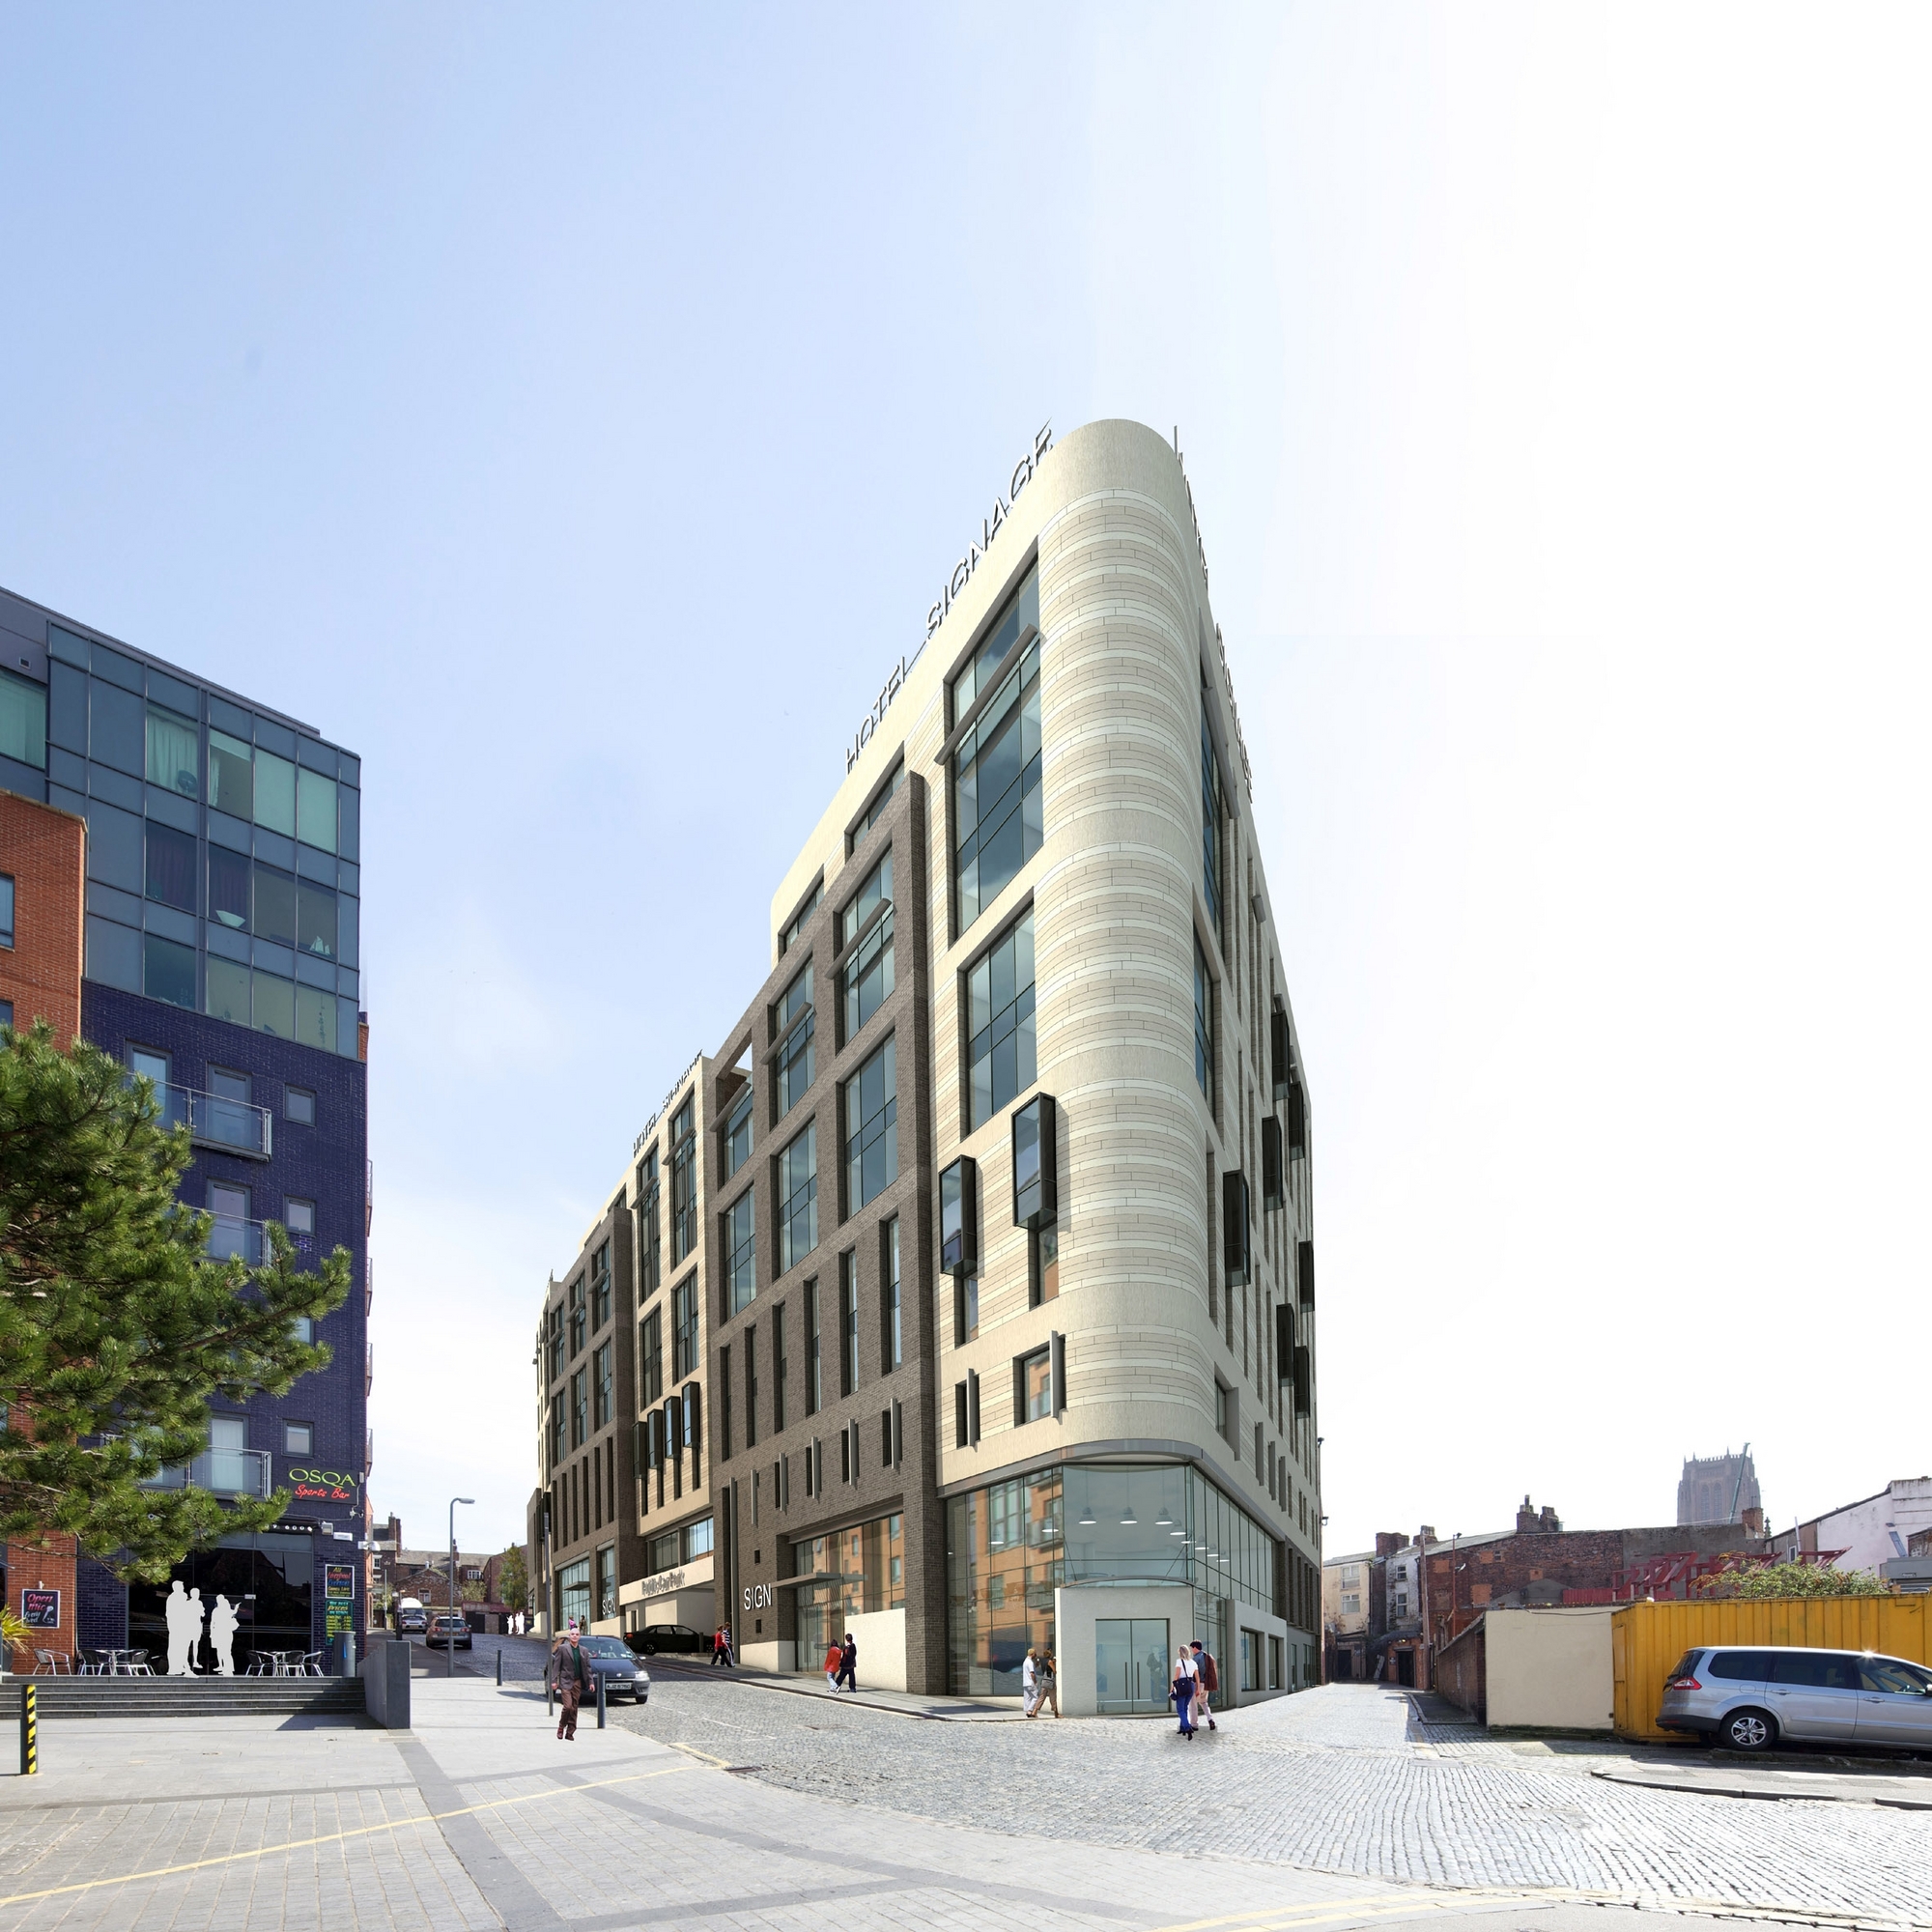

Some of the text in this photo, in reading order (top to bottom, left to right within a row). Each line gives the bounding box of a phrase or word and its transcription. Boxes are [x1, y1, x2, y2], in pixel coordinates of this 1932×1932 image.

[846, 415, 1054, 775] HOTEL SIGNAGE
[289, 1468, 356, 1489] OSQA
[295, 1484, 350, 1499] Sports Bar
[27, 1593, 53, 1604] Open
[602, 1597, 616, 1616] SIGN
[744, 1583, 772, 1610] SIGN
